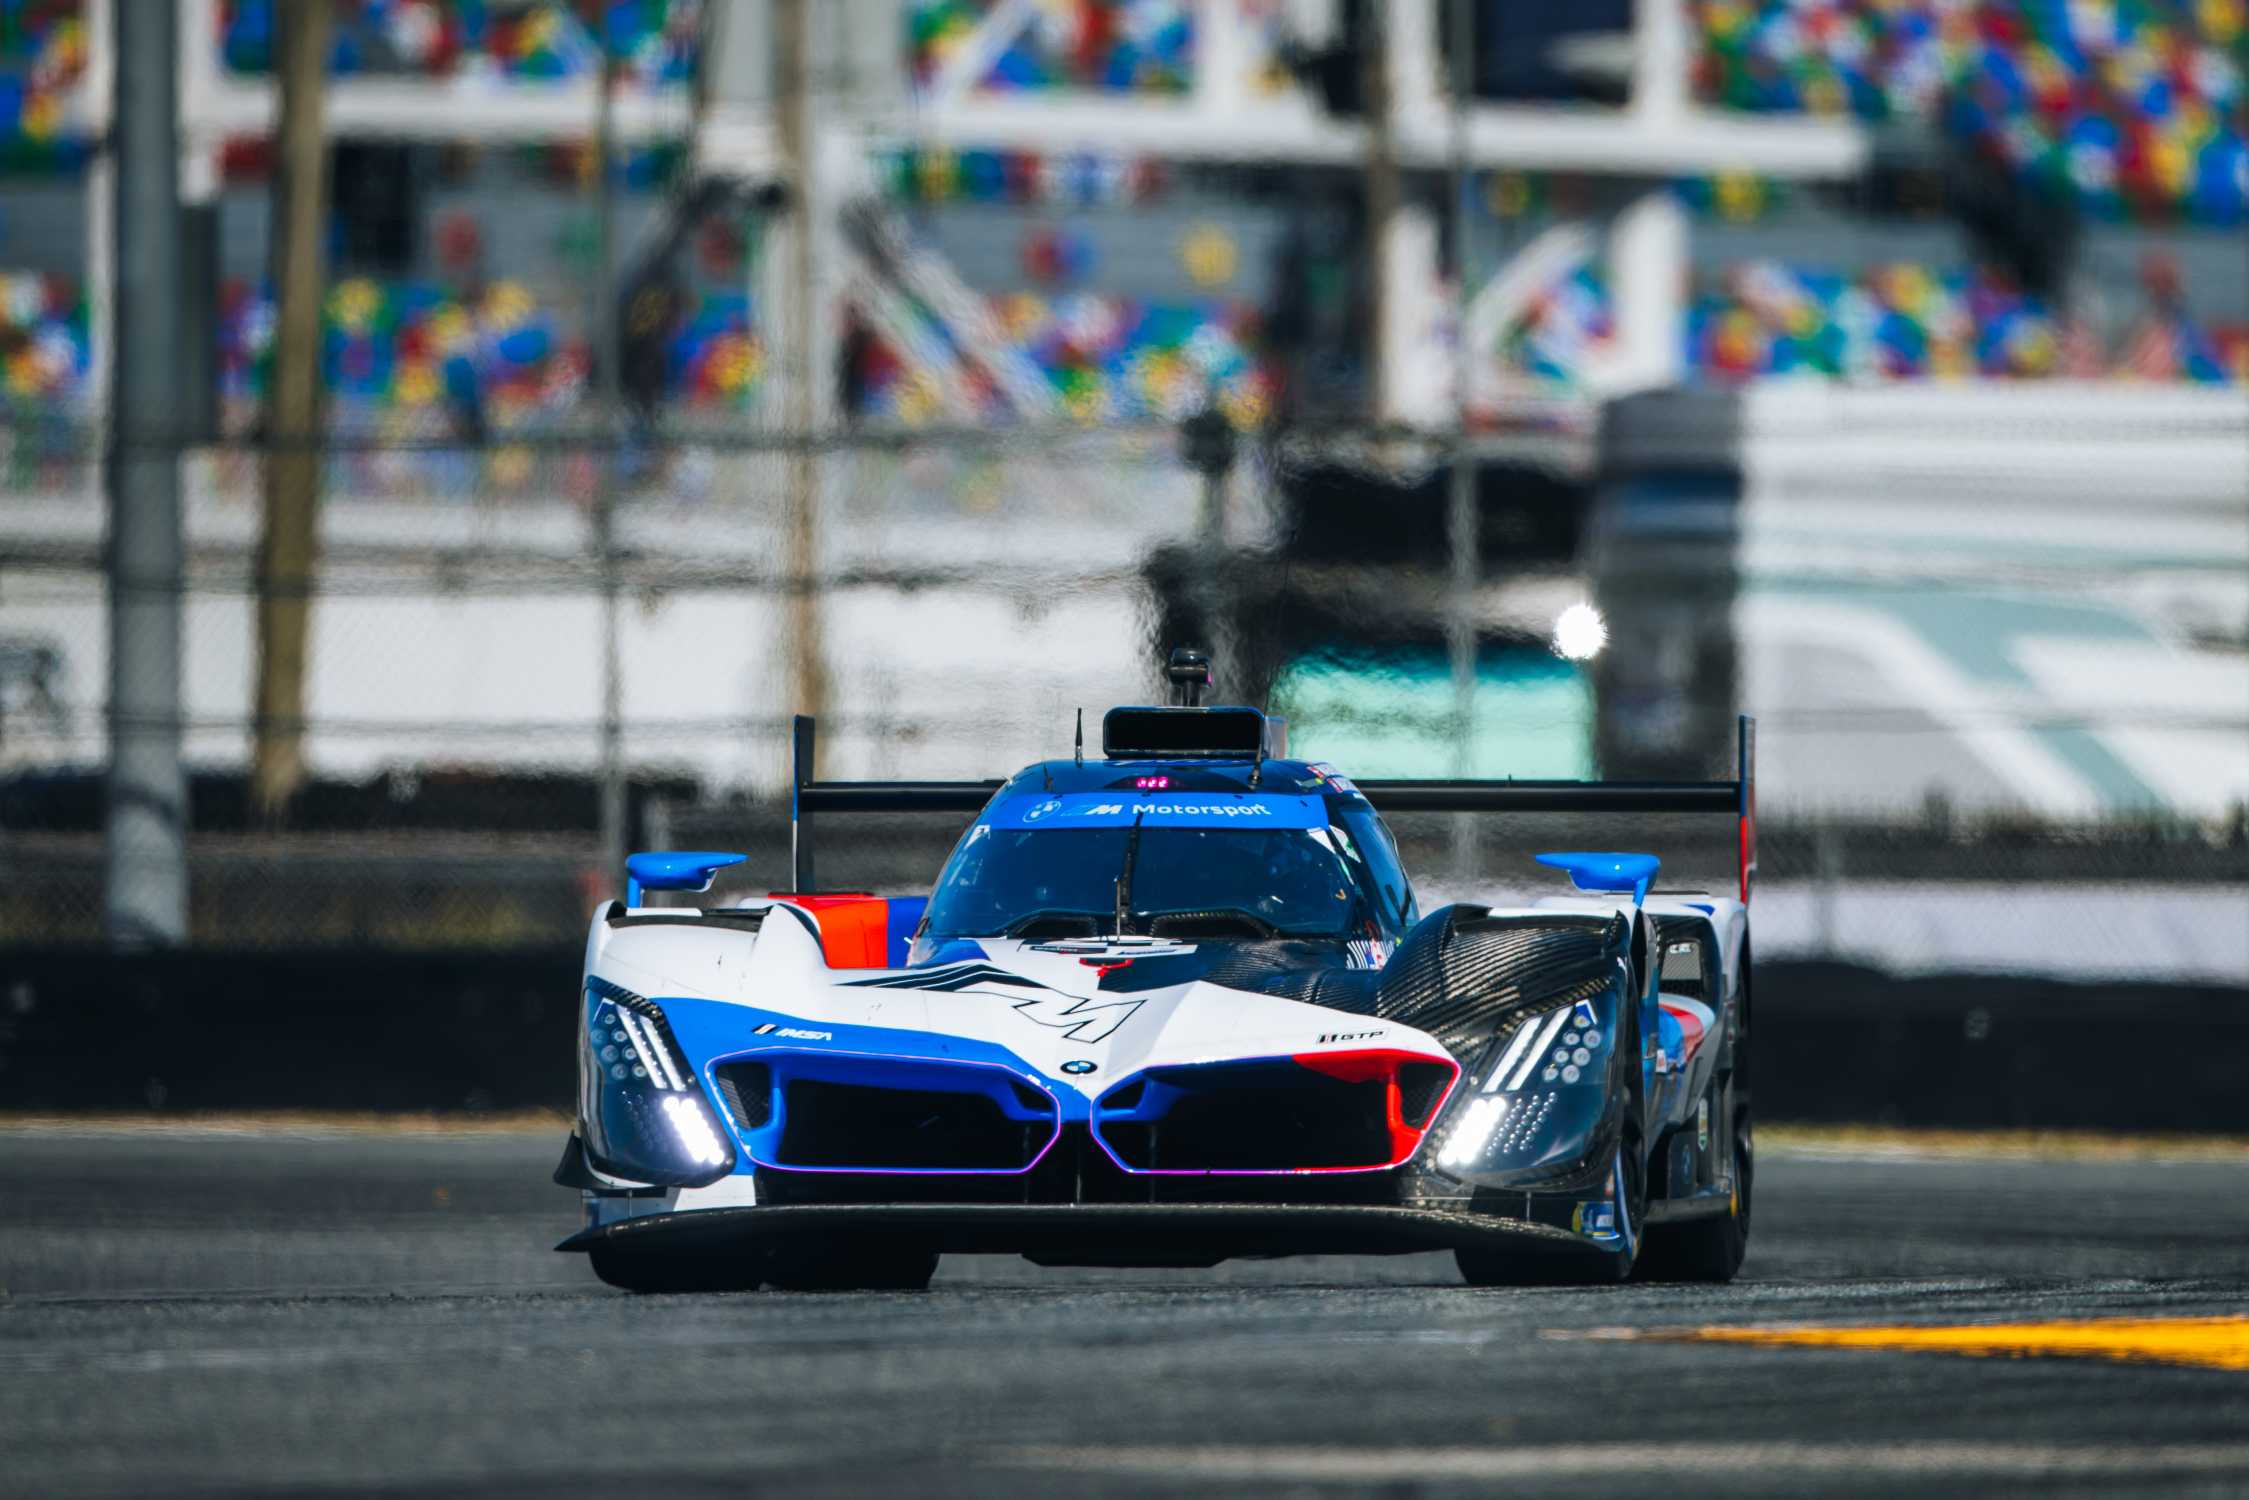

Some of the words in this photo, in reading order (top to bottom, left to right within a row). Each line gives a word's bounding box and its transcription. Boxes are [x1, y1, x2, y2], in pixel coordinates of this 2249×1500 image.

[1132, 803, 1272, 817] Motorsport
[775, 1027, 832, 1041] IMSA
[1340, 1031, 1384, 1041] GTP
